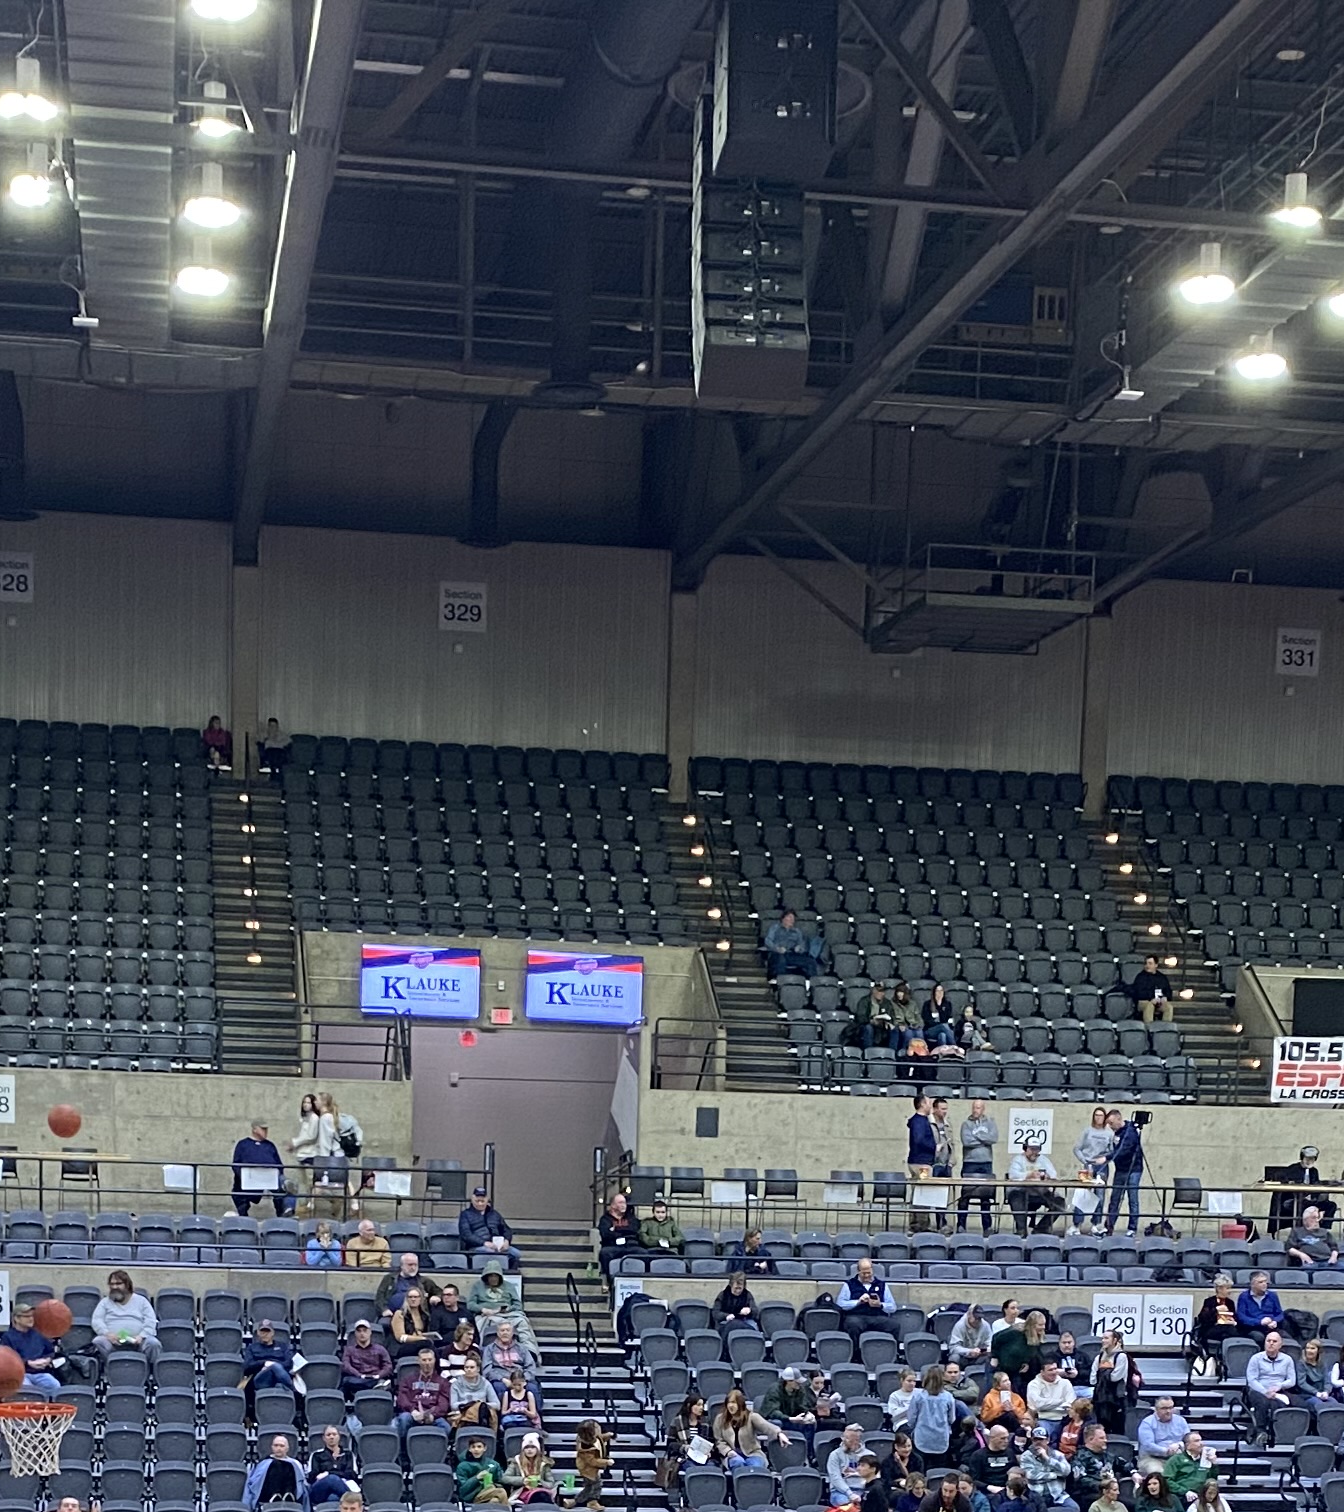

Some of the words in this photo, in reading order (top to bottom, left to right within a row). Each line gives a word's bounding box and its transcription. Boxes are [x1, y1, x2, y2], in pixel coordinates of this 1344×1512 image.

[444, 603, 481, 622] 329
[1282, 649, 1314, 667] 331
[381, 975, 461, 1000] KLAUKE
[545, 981, 624, 1005] KLAUKE
[1279, 1041, 1343, 1062] 105.5
[1279, 1089, 1297, 1099] LA
[1014, 1117, 1049, 1126] Section
[1097, 1304, 1137, 1314] Section
[1148, 1305, 1188, 1315] Section
[1099, 1316, 1136, 1335] 129
[1150, 1317, 1186, 1335] 130
